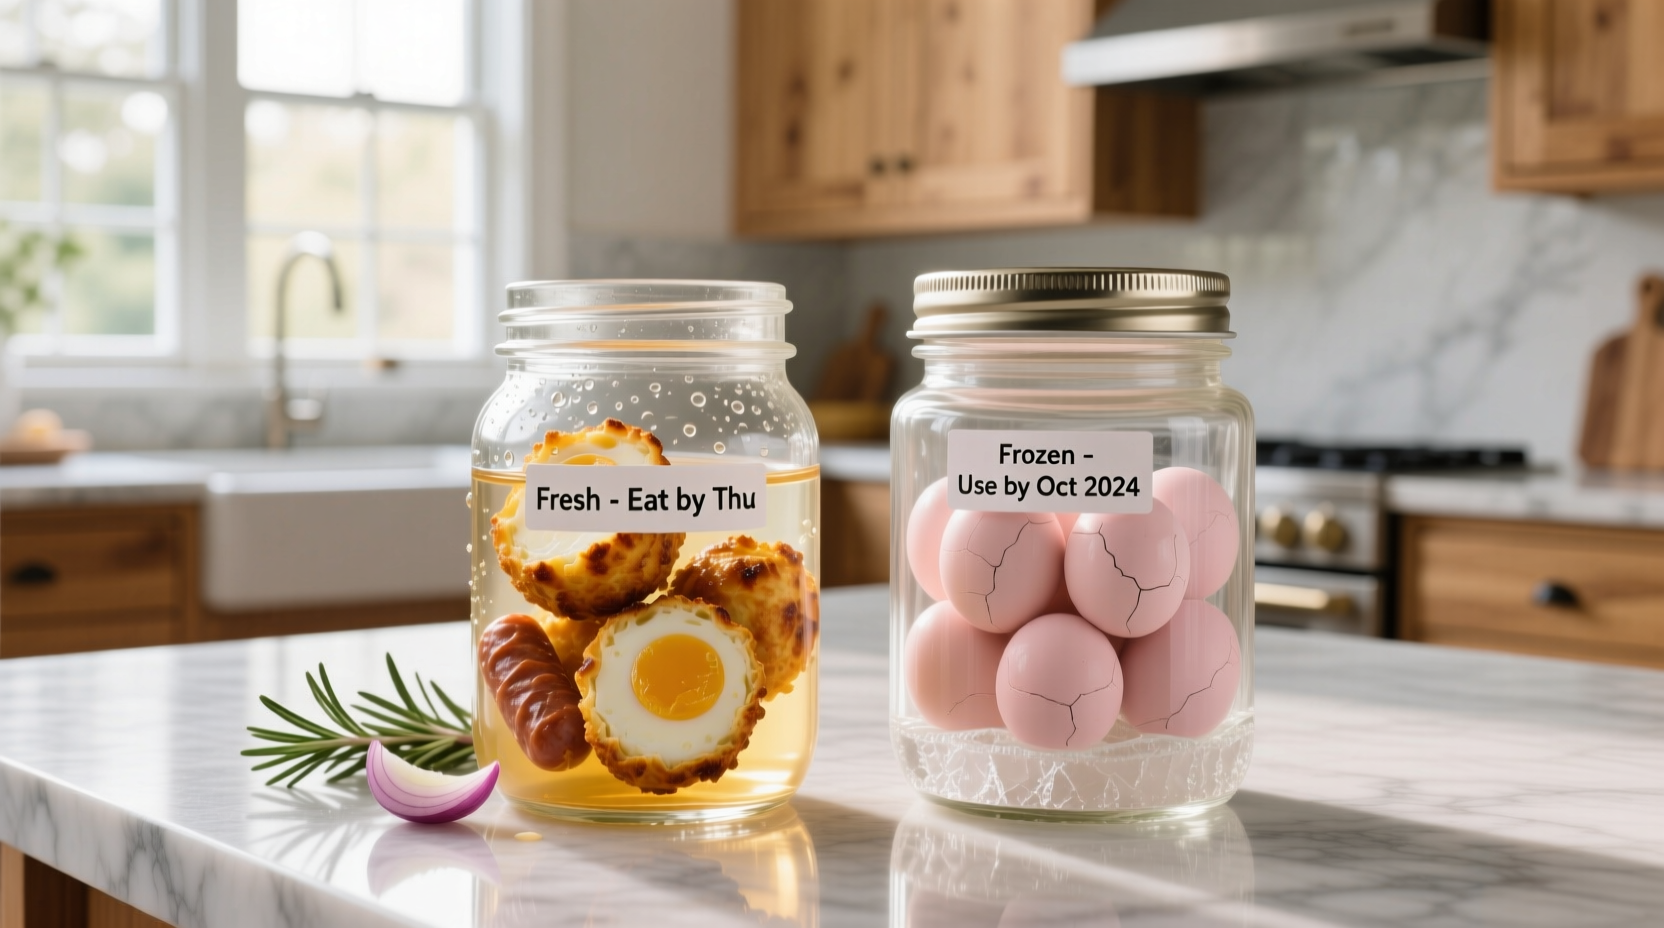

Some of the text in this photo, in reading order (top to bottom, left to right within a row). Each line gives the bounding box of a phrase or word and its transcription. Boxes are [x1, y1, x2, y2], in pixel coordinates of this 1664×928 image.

[999, 443, 1075, 465] Frozen
[537, 486, 601, 512] Fresh
[628, 487, 669, 512] Eat
[676, 486, 706, 518] by
[712, 485, 756, 511] Thu
[958, 473, 1141, 502] Use by Oct 2024
